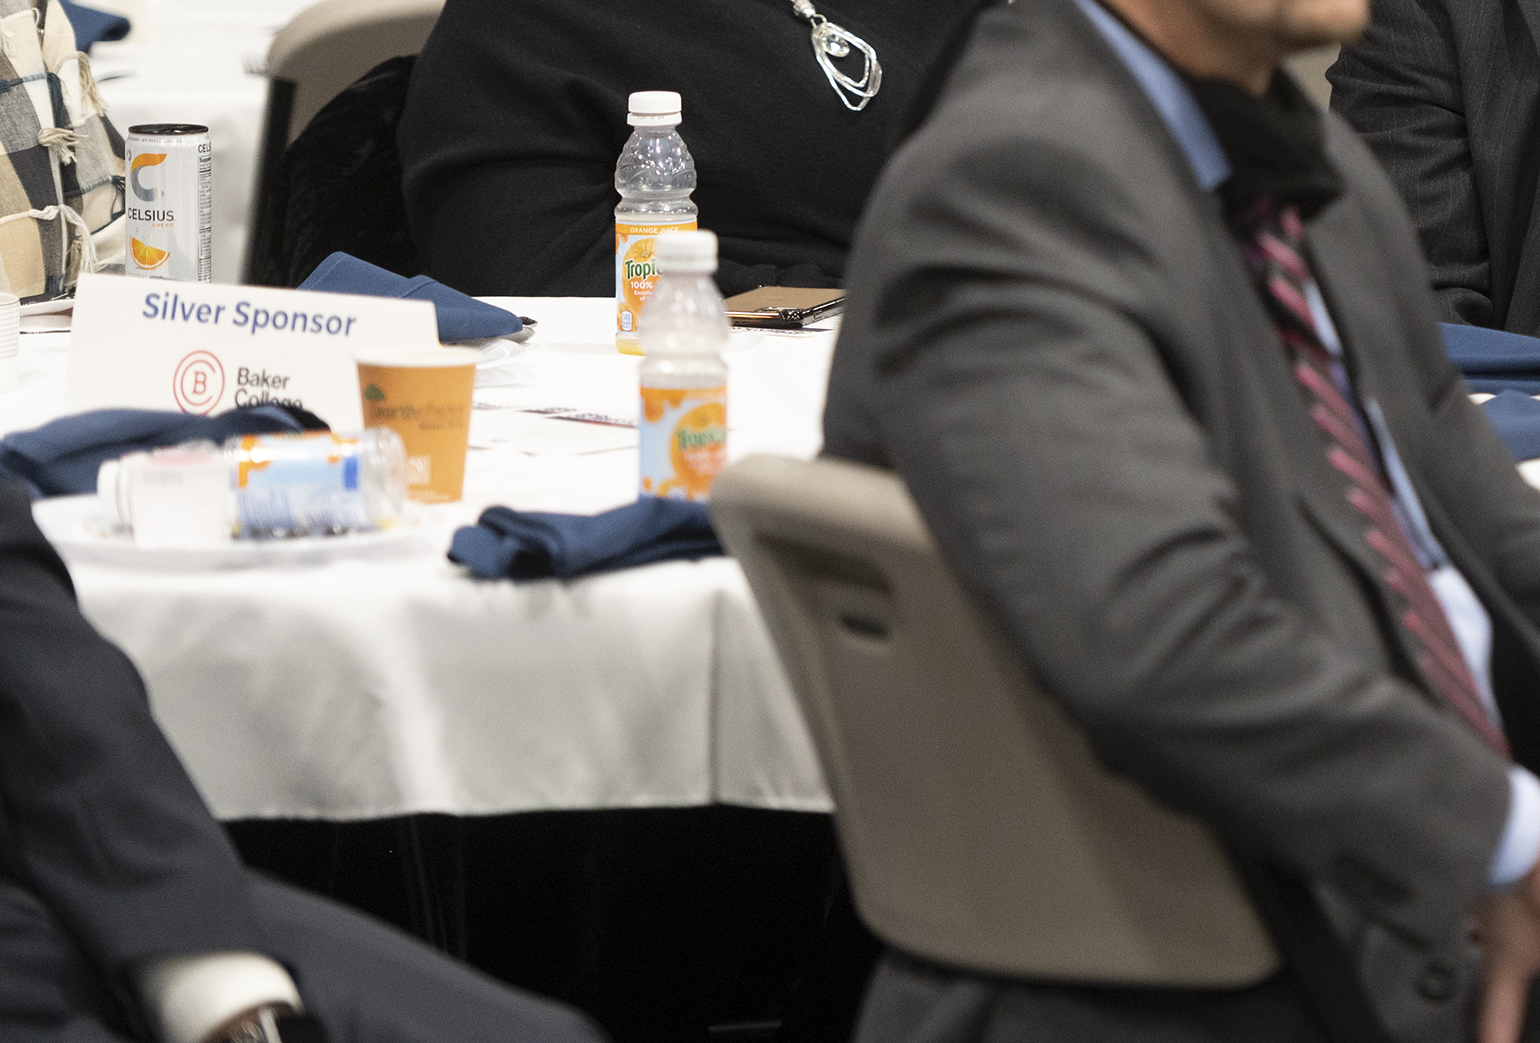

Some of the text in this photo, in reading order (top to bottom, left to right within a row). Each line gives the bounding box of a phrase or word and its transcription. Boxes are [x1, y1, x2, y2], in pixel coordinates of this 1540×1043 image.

[128, 207, 175, 222] CELSIUS
[630, 281, 654, 289] 100%
[142, 292, 357, 336] Silver Sponsor
[237, 367, 290, 390] Baker
